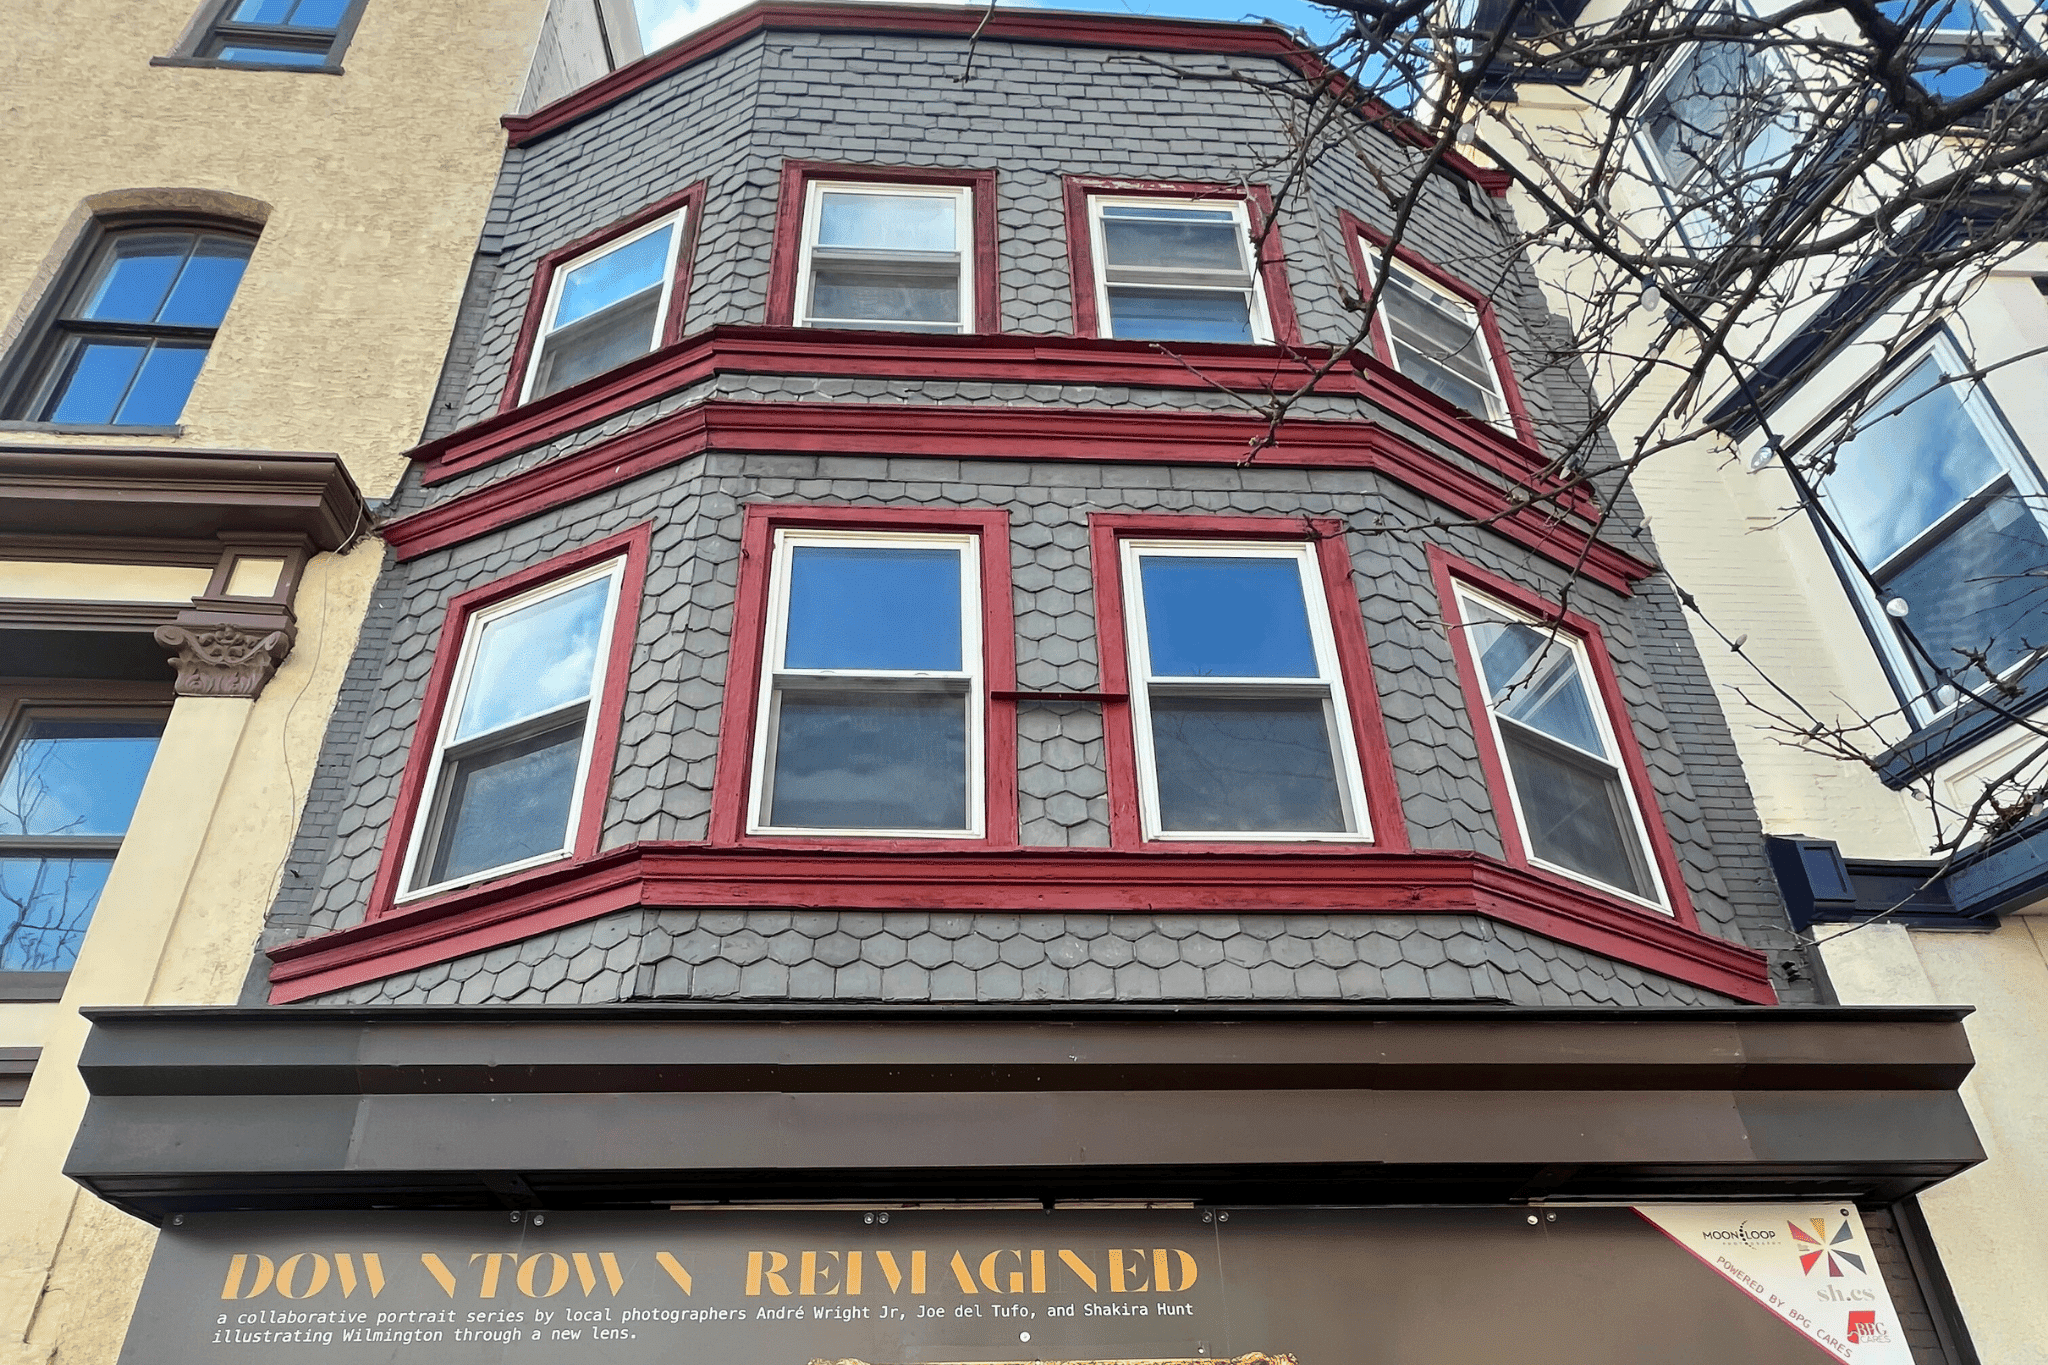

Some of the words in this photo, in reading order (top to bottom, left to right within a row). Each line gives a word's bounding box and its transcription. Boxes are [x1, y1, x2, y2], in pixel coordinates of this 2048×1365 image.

[1702, 1230, 1739, 1240] MOON
[1745, 1230, 1776, 1240] LOOP
[745, 1248, 1199, 1296] REIMAGINED
[216, 1313, 228, 1325] a
[237, 1309, 368, 1325] collaborative
[375, 1308, 457, 1326] portrait
[466, 1308, 525, 1323] series
[534, 1307, 555, 1325] by
[565, 1306, 612, 1322] local
[621, 1305, 747, 1325] photographers
[755, 1304, 805, 1320] André
[813, 1303, 870, 1323] Wright
[879, 1304, 906, 1321] Jr,
[916, 1303, 946, 1319] Joe
[954, 1303, 983, 1318] del
[991, 1303, 1036, 1319] Tufo,
[1047, 1302, 1075, 1317] and
[1083, 1302, 1149, 1317] Shakira
[1157, 1301, 1194, 1316] Hunt
[1716, 1256, 1764, 1294] POWERED
[1768, 1294, 1785, 1308] BY
[1788, 1308, 1812, 1329] BPG
[1816, 1329, 1853, 1358] CARES
[211, 1327, 333, 1346] illustrating
[342, 1326, 443, 1345] Wilmington
[453, 1325, 522, 1345] through
[530, 1329, 542, 1341] a
[551, 1329, 582, 1341] new
[592, 1325, 638, 1340] lens.
[1854, 1322, 1887, 1336] BPG
[1859, 1334, 1891, 1344] CARES
